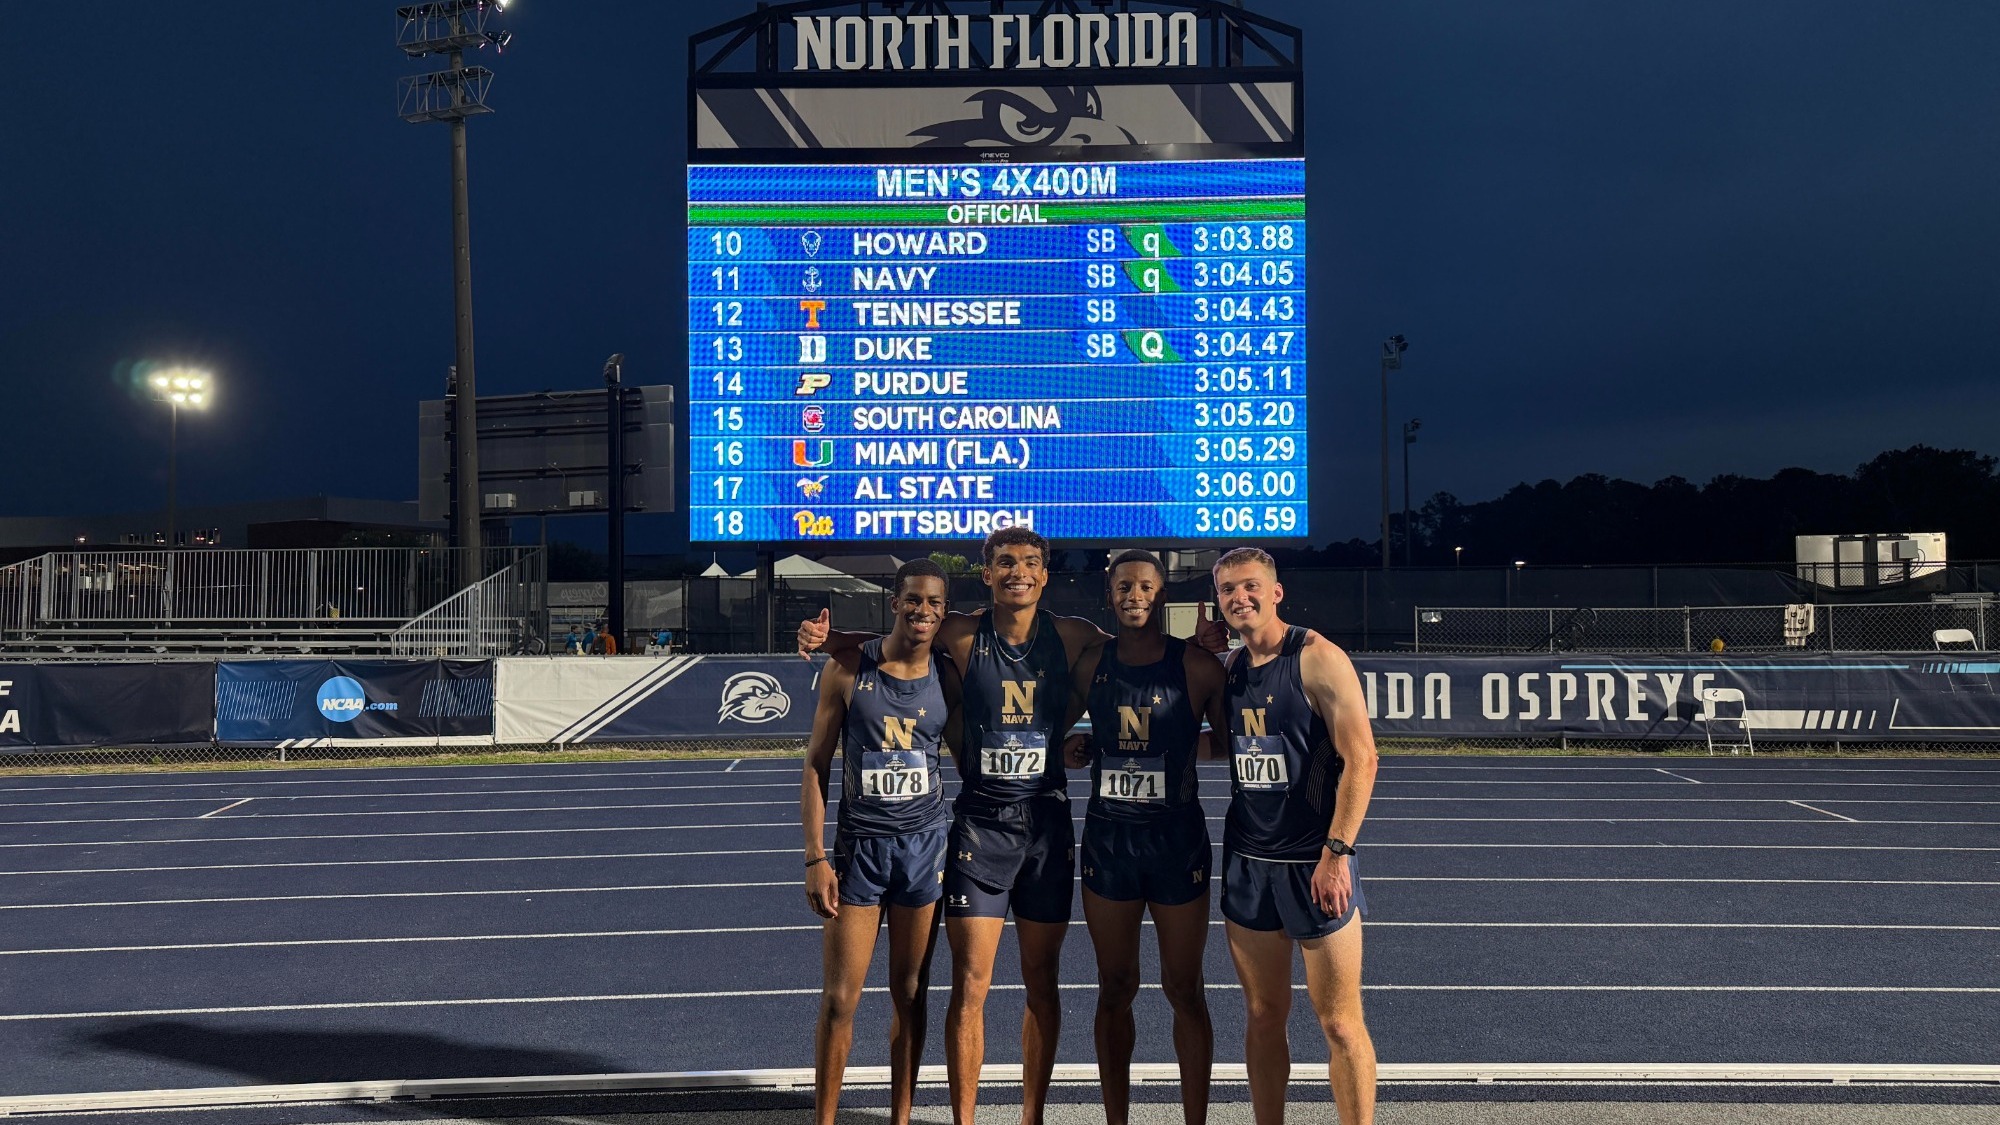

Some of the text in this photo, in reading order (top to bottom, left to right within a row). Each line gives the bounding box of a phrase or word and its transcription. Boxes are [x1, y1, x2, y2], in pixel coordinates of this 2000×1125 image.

[793, 12, 1197, 70] NORTH FLORIDA
[992, 167, 1117, 196] 4X400M
[947, 204, 1047, 224] OFFICIAL
[712, 225, 1294, 258] 10 HOWARD SB q 3:03.88
[712, 261, 1294, 293] 11 NAVY SB q 3:04.05
[713, 302, 742, 325] 12
[853, 302, 1021, 325] TENNESSEE
[1087, 299, 1115, 322] SB
[1194, 297, 1294, 321] 3:04.43
[713, 337, 742, 360] 13
[855, 337, 932, 360] DUKE
[1087, 334, 1115, 357] SB
[1140, 334, 1164, 359] Q
[1194, 331, 1294, 356] 3:04.47
[713, 372, 743, 395] 14
[854, 372, 968, 395] PURDUE
[1194, 366, 1291, 391] 3:05.11
[713, 407, 743, 430] 15
[854, 407, 934, 430] SOUTH
[939, 406, 1061, 430] CAROLINA
[1195, 402, 1295, 426] 3:05.20
[713, 442, 743, 465] 16
[855, 442, 938, 465] MIAMI
[947, 438, 1030, 470] (FLA.)
[1195, 437, 1295, 462] 3:05.29
[713, 472, 1296, 499] 17 AL STATE 3:06.00
[713, 507, 1296, 536] 18 Pitt PITTSBURGH 3:06.59
[1002, 681, 1037, 714] N
[1482, 673, 1715, 721] OSPREYS
[881, 716, 917, 750] N
[1002, 715, 1033, 725] NAVY
[1118, 706, 1152, 740] N
[1242, 708, 1267, 737] N
[1118, 740, 1149, 751] NAVY
[988, 752, 1040, 774] 1072
[1237, 757, 1280, 782] 1070
[870, 771, 923, 795] 1078
[1108, 773, 1158, 798] 1071
